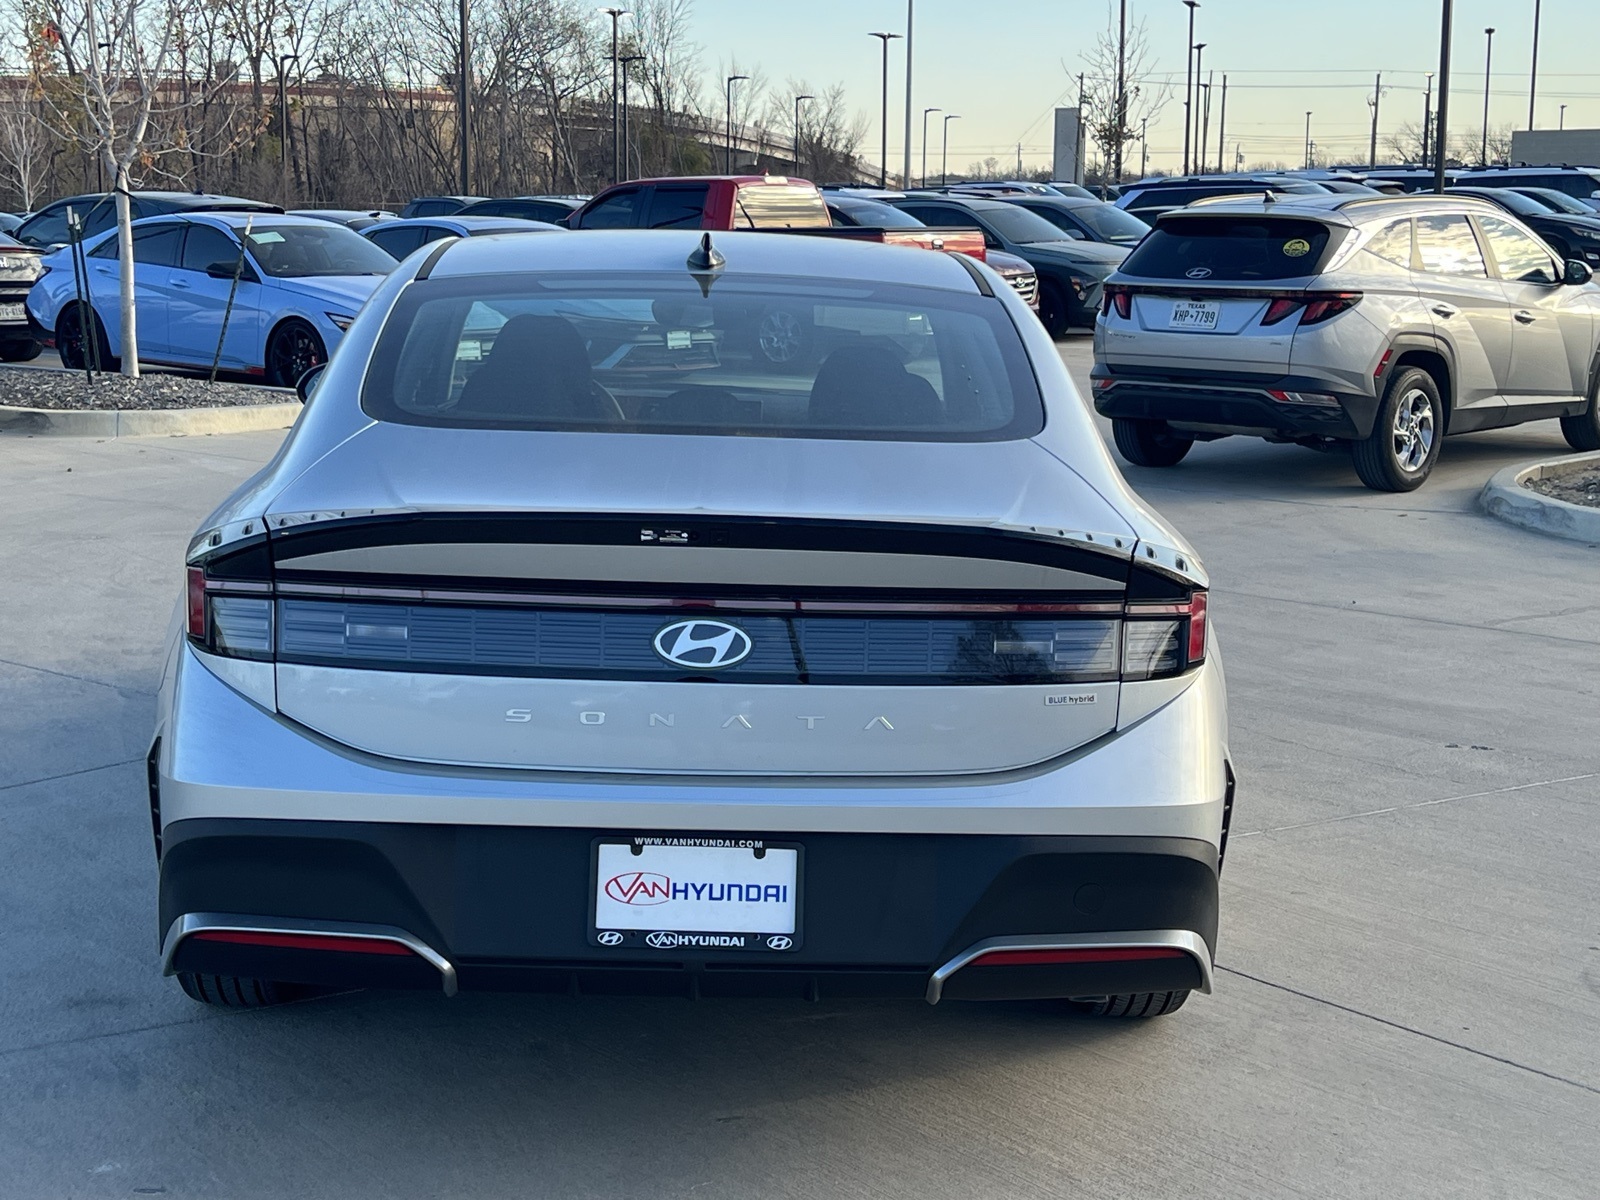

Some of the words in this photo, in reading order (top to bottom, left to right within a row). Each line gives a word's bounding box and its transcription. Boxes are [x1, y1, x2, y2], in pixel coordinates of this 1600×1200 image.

[1048, 696, 1067, 704] BLUE
[1068, 695, 1095, 704] hybrid
[505, 708, 895, 731] SONATA
[634, 837, 763, 849] WWW.VANHYUNDAI.COM
[672, 883, 788, 903] HYUNDAI
[678, 935, 745, 947] HYUNDAI
